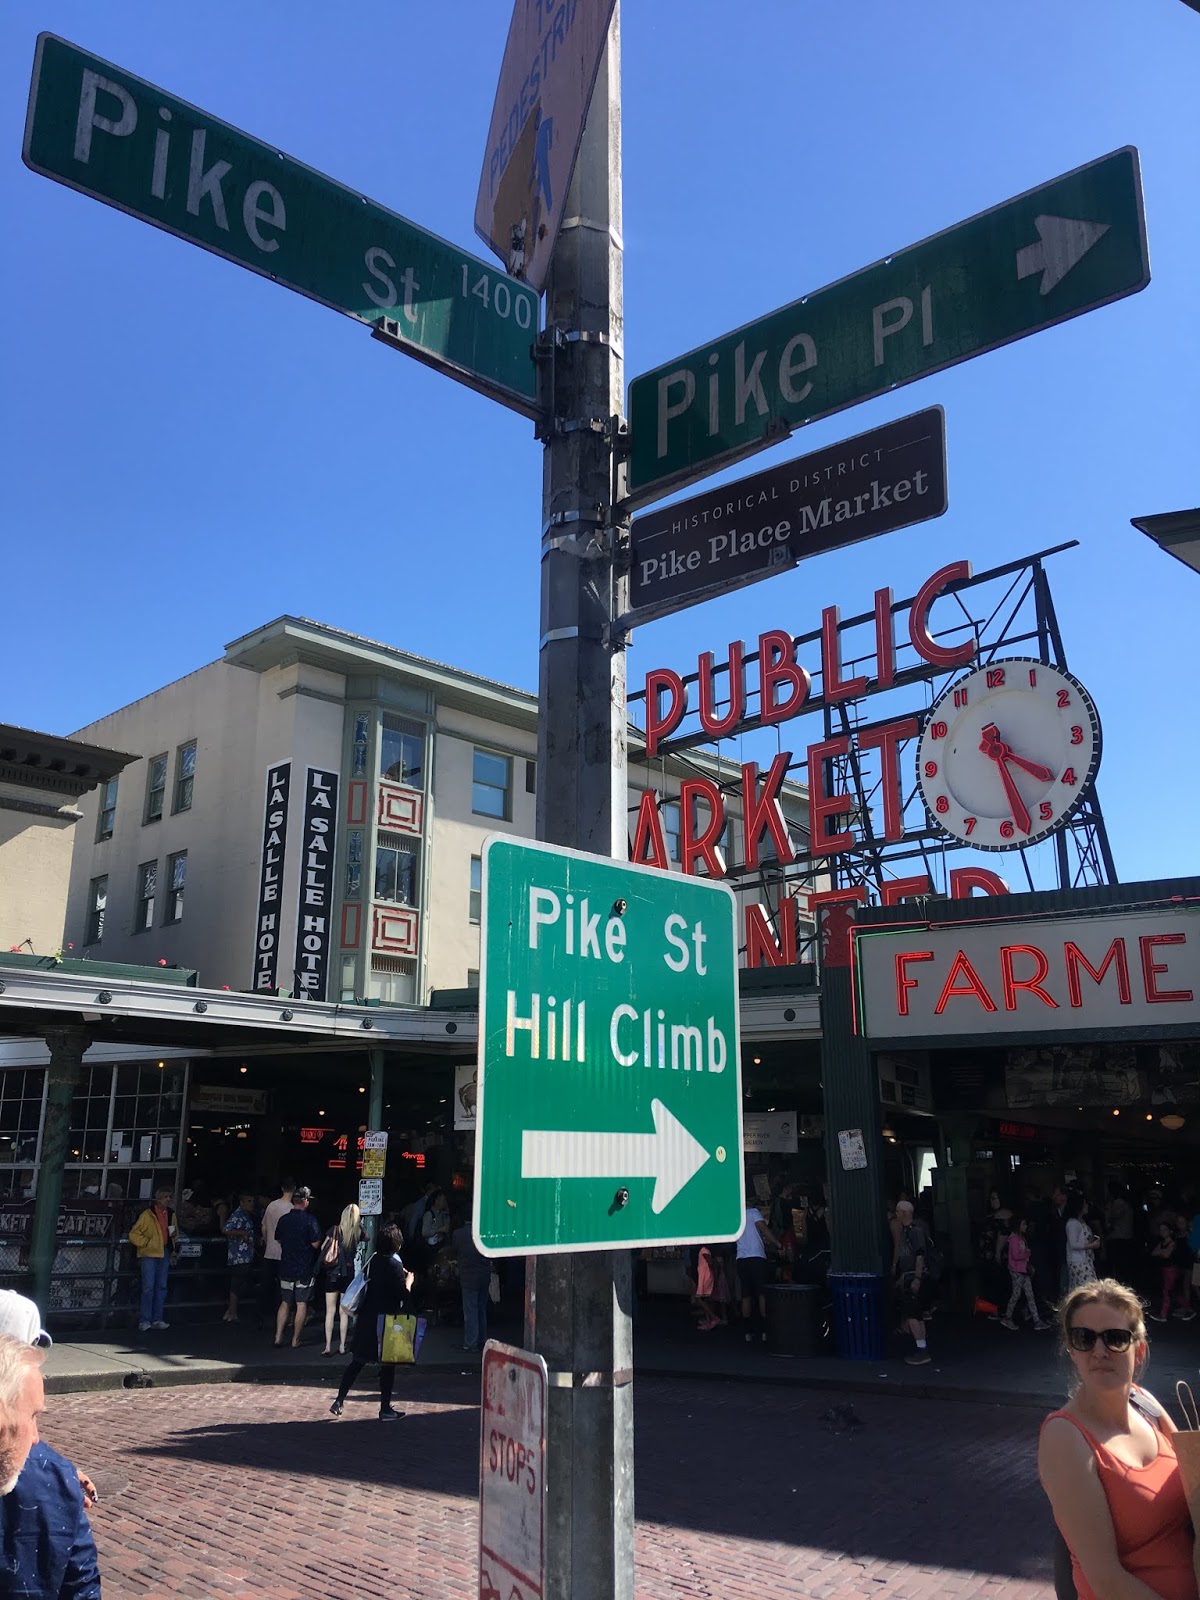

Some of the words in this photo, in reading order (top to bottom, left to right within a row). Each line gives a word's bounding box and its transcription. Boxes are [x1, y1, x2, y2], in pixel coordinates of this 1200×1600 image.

[73, 68, 286, 253] Pike
[362, 246, 420, 323] St
[461, 264, 532, 329] 1400
[657, 332, 818, 459] Pike
[873, 284, 934, 367] Pl
[672, 487, 780, 535] HISTORICAL
[789, 449, 885, 494] DISTRICT
[640, 547, 701, 586] Pike
[708, 519, 791, 564] Place
[800, 468, 929, 535] Market
[645, 560, 977, 757] PUBLIC
[986, 668, 1005, 688] 12
[1029, 669, 1037, 687] 1
[954, 688, 968, 709] 11
[1056, 689, 1071, 708] 2
[931, 722, 947, 740] 10
[1070, 726, 1083, 745] 3
[925, 761, 938, 778] 9
[1061, 767, 1077, 785] 4
[269, 771, 286, 806] LA
[311, 772, 331, 809] LA
[631, 718, 919, 879] ARKET
[936, 795, 949, 813] 8
[963, 818, 977, 836] 7
[1000, 820, 1014, 839] 6
[1039, 802, 1053, 821] 5
[262, 810, 284, 902] SALLE
[304, 817, 329, 906] SALLE
[528, 885, 627, 963] Pike
[664, 913, 707, 976] St
[894, 933, 1194, 1016] FARME
[505, 990, 586, 1063] Hill
[609, 1003, 727, 1074] Climb
[0, 1213, 31, 1233] KET
[489, 1428, 536, 1496] STOPS
